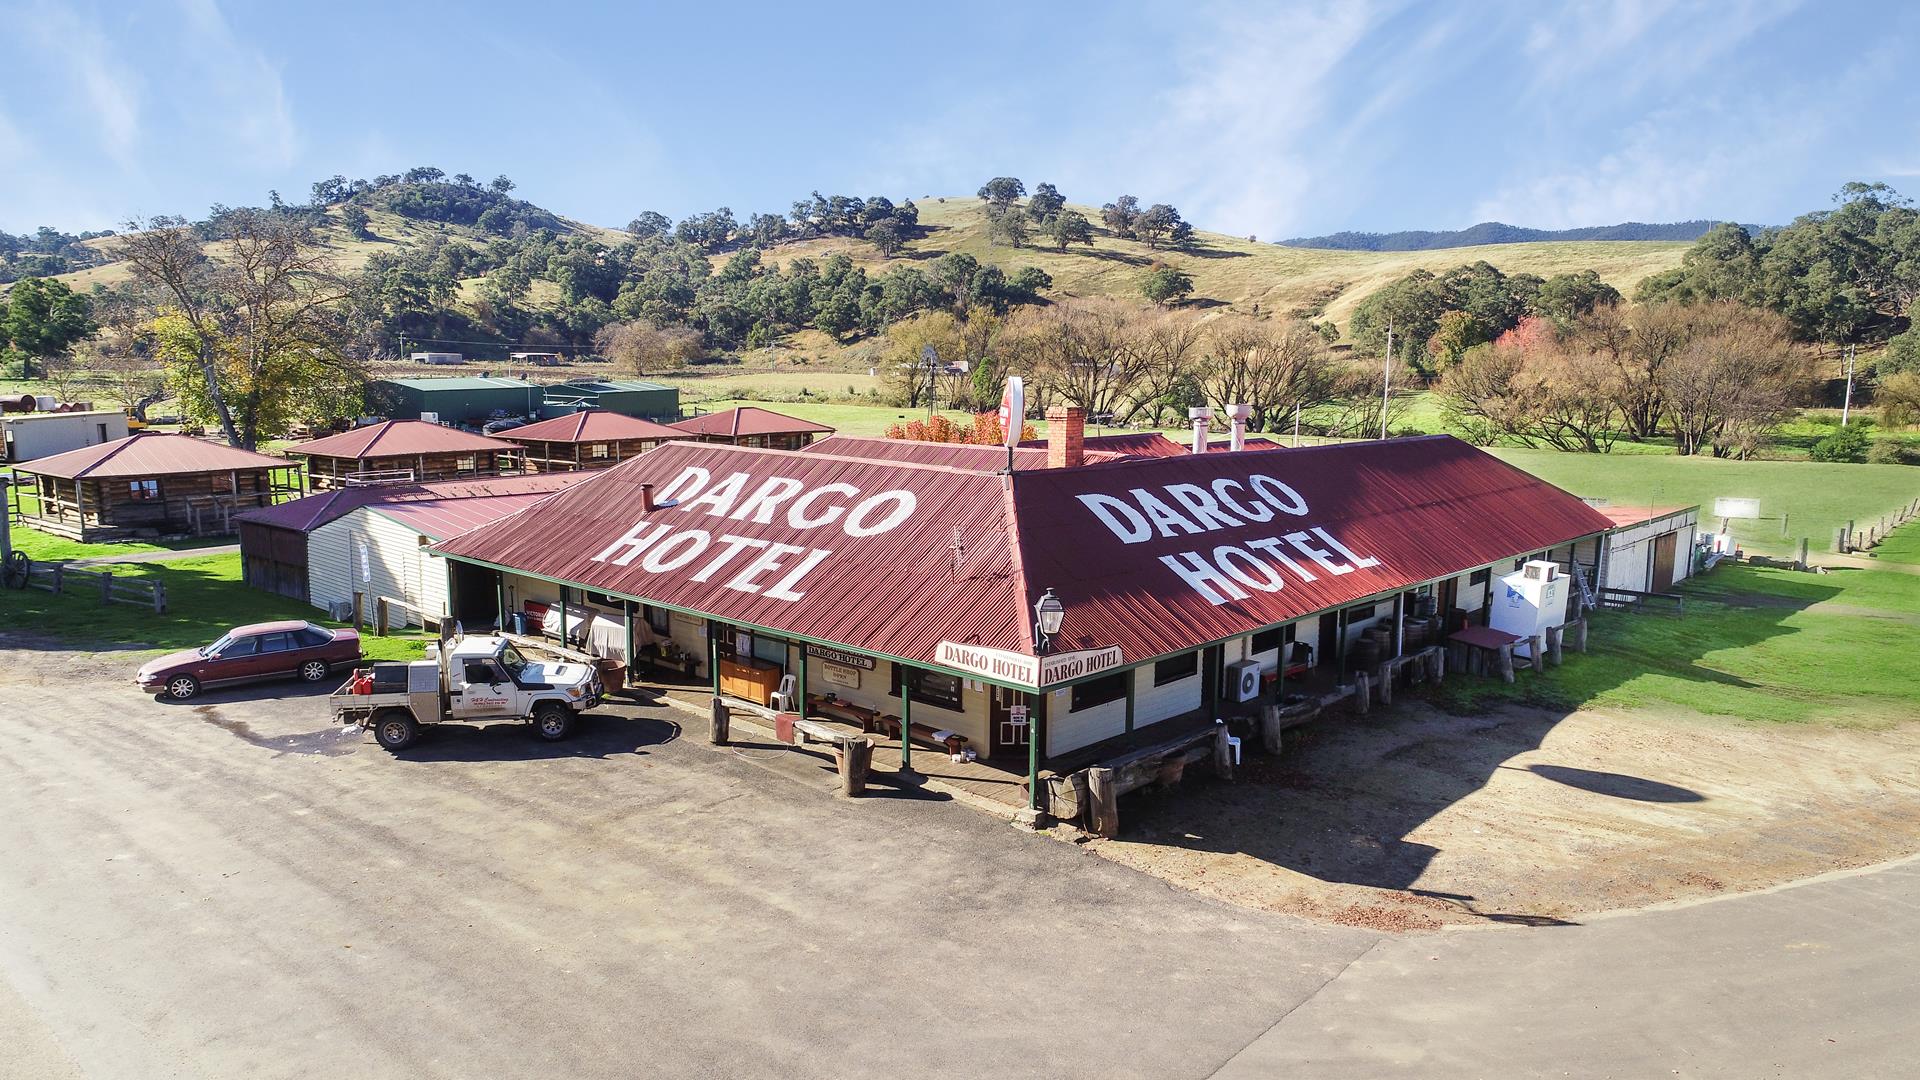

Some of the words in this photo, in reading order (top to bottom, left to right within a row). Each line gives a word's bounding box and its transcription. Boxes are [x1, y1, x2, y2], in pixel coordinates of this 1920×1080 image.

[654, 466, 917, 537] DARGO
[1075, 474, 1309, 544] DARGO
[590, 520, 832, 602] HOTEL
[1158, 526, 1381, 606] HOTEL
[808, 646, 837, 660] DARGO
[838, 654, 868, 667] HOTEL
[945, 645, 988, 670] DARGO
[992, 658, 1034, 684] HOTEL
[1044, 659, 1083, 685] DARGO
[1086, 649, 1118, 672] HOTEL
